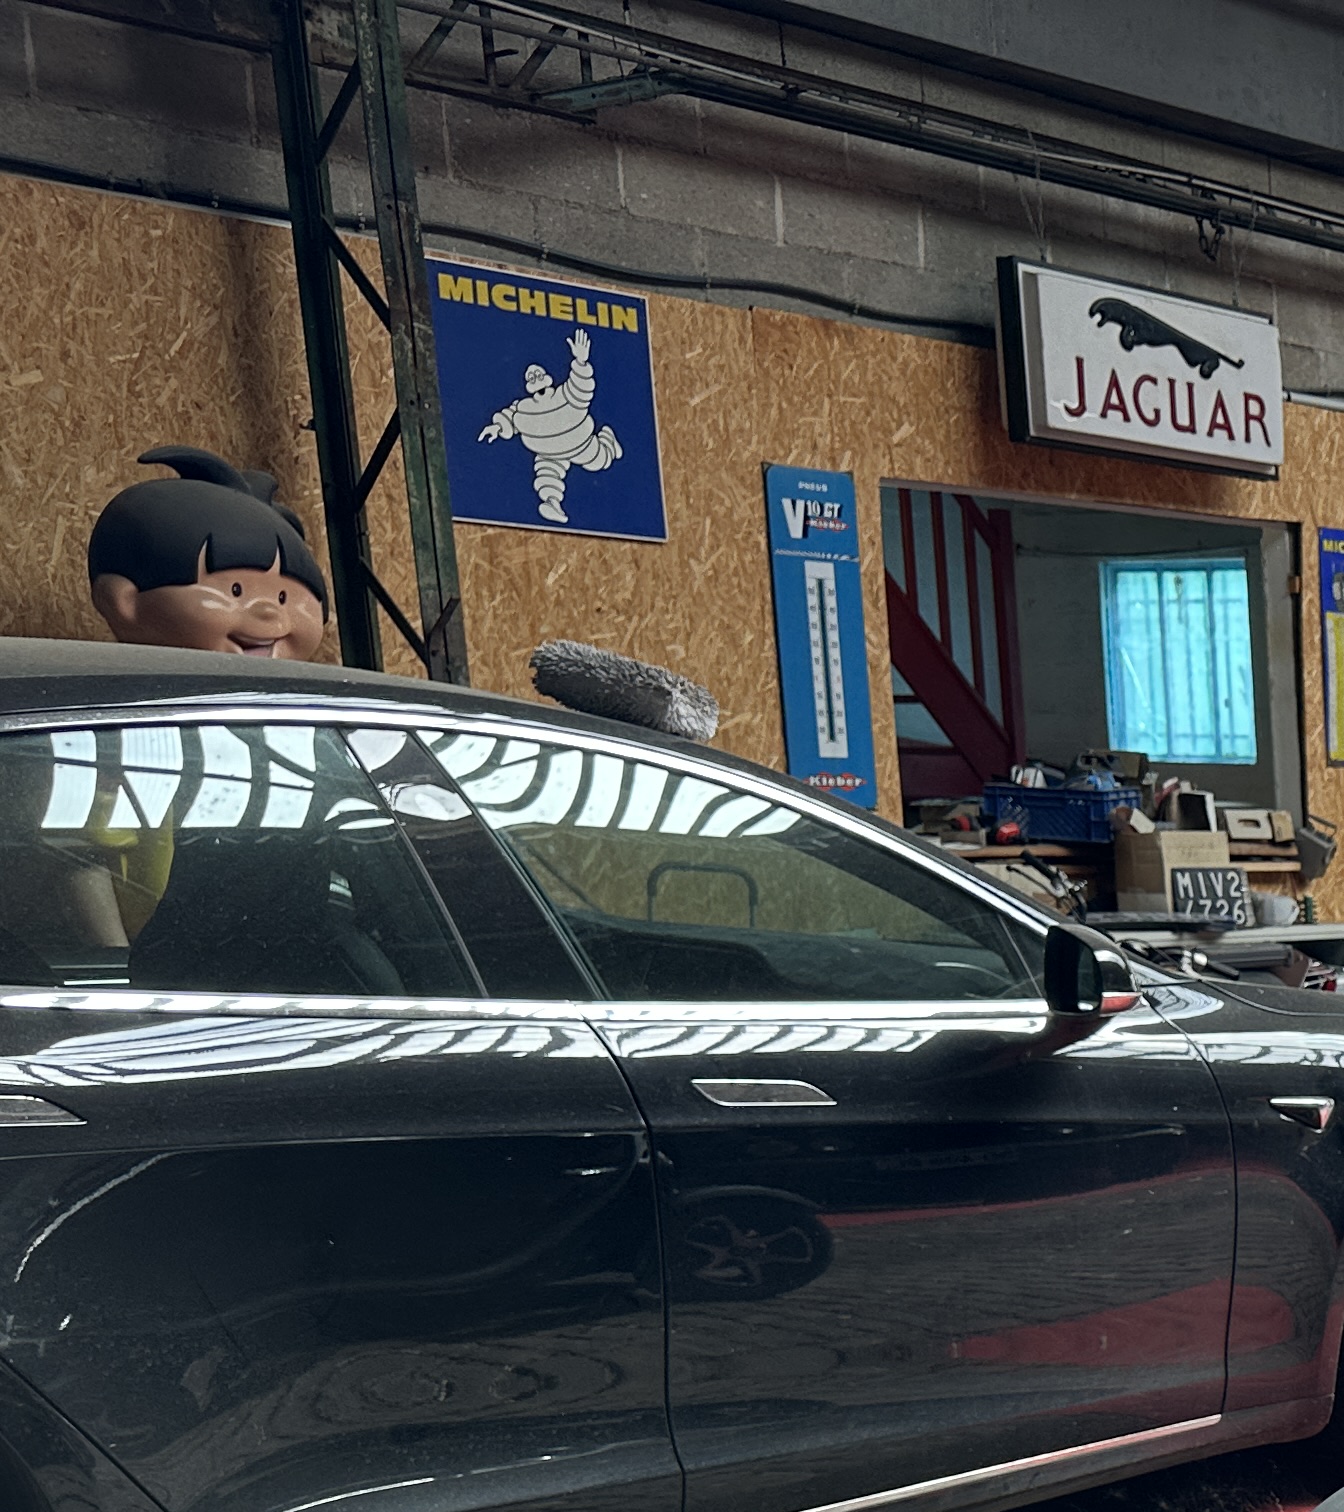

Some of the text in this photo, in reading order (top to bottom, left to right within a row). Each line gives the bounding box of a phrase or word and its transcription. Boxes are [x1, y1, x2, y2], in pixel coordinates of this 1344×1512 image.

[437, 272, 639, 333] MICHELIN
[1063, 356, 1272, 448] JAGUAR
[1176, 871, 1242, 898] MIV2
